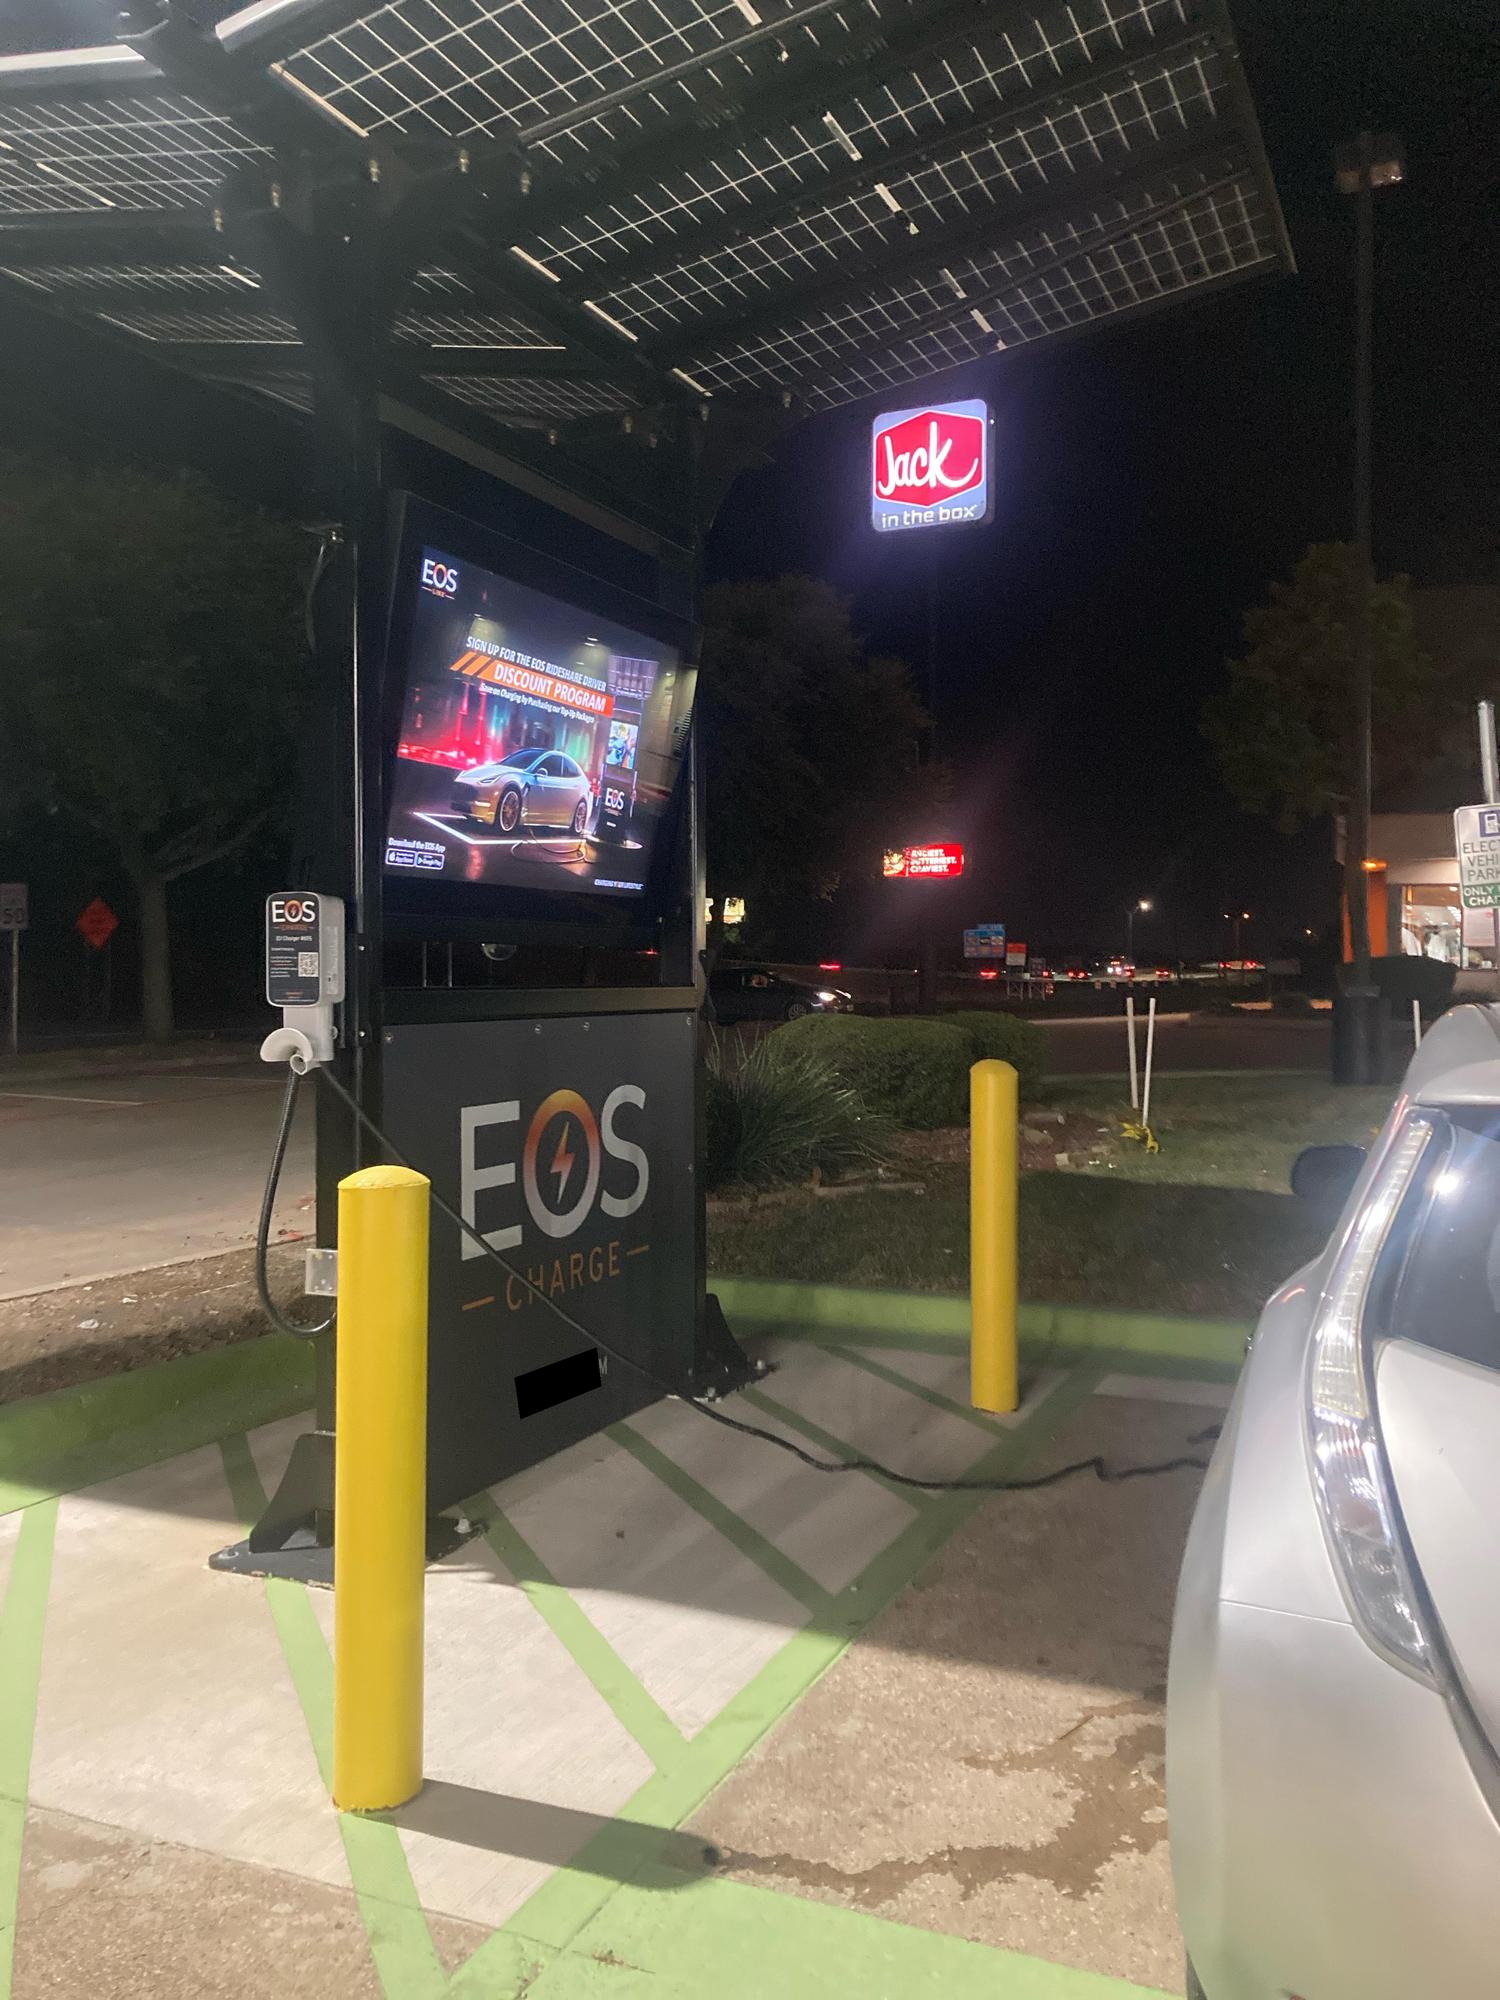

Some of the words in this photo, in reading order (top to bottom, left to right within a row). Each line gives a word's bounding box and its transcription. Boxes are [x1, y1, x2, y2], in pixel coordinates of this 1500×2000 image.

[878, 421, 979, 496] Jack
[882, 512, 899, 528] in
[903, 509, 934, 525] the
[939, 505, 976, 521] box
[422, 559, 458, 593] EOS
[466, 636, 487, 651] SIGN
[487, 643, 500, 655] UP
[499, 647, 516, 662] FOR
[516, 652, 531, 666] THE
[531, 658, 546, 672] EOS
[545, 662, 583, 684] RIDESHARE
[583, 676, 607, 692] DRIVER
[494, 664, 554, 695] DISCOUNT
[554, 683, 607, 712] PROGRAM
[500, 689, 522, 703] Charging
[521, 695, 528, 706] by
[605, 787, 625, 810] EOS
[1463, 840, 1500, 854] ELEC
[1467, 854, 1499, 867] VEHI
[1463, 886, 1493, 896] ONLY
[271, 900, 316, 923] EOS
[460, 1084, 650, 1261] EOS
[506, 1241, 622, 1311] CHARGE
